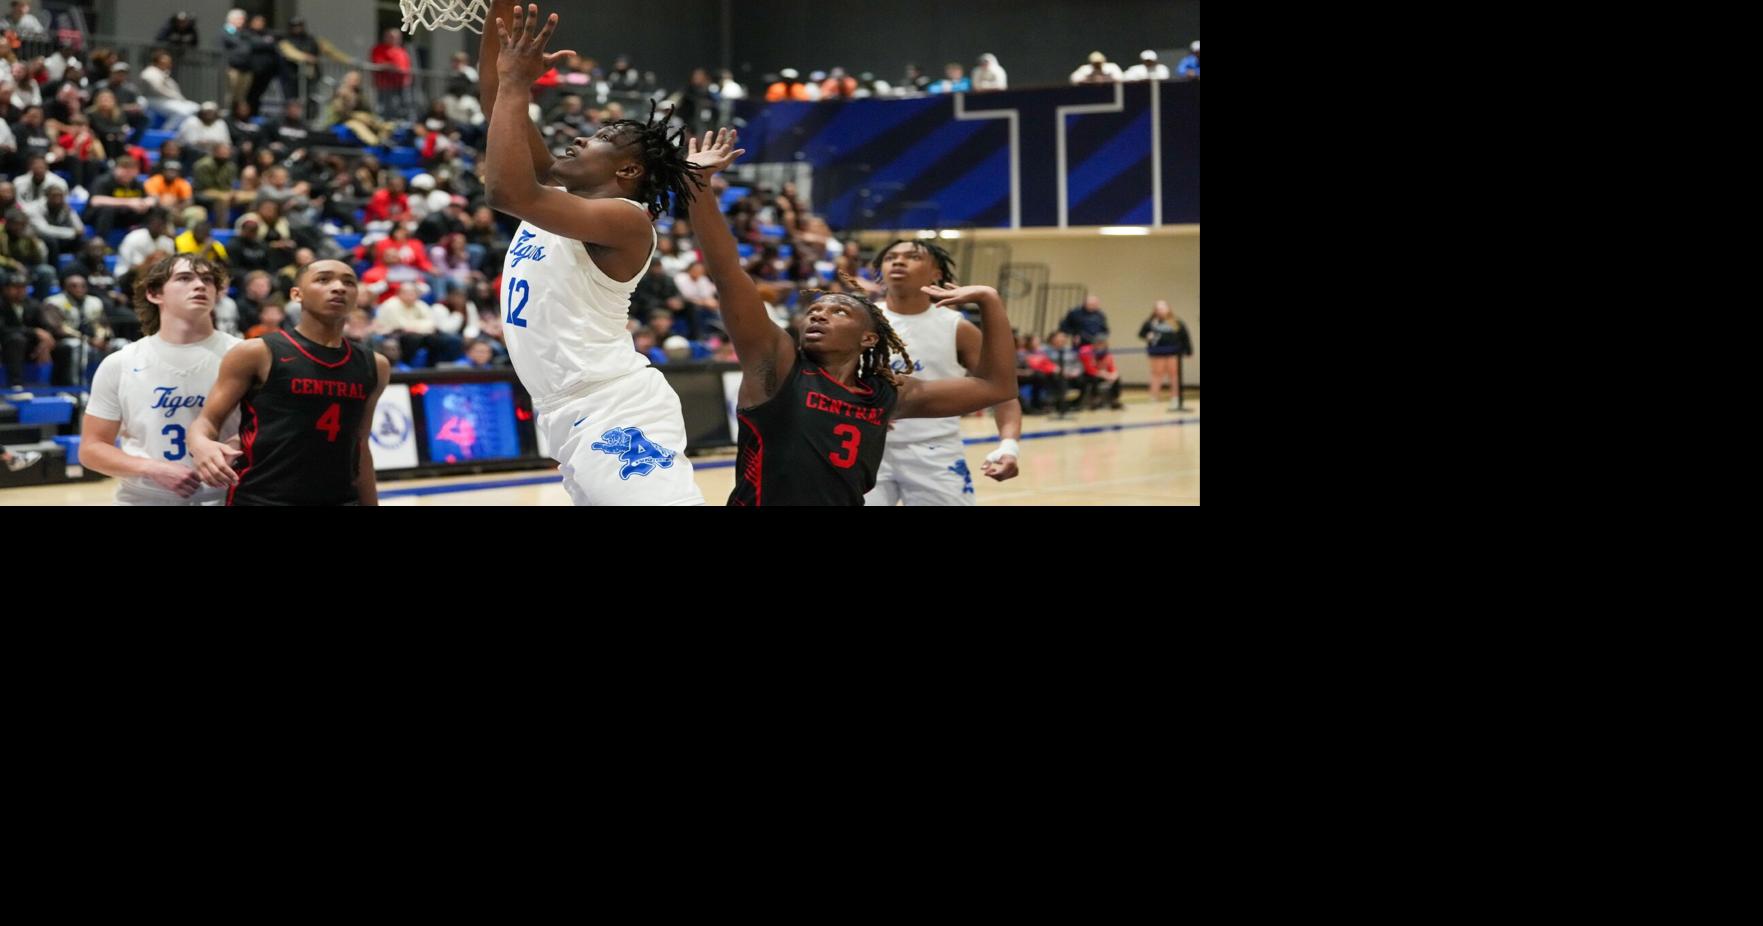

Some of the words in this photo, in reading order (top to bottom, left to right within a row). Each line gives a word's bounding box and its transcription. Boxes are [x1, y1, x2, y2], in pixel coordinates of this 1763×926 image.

[506, 277, 529, 328] 12
[151, 386, 205, 418] Tiger
[290, 378, 366, 400] CENTRAL
[315, 403, 341, 443] 4
[805, 391, 885, 426] CENTRAL
[161, 424, 194, 461] 3
[828, 423, 862, 469] 3
